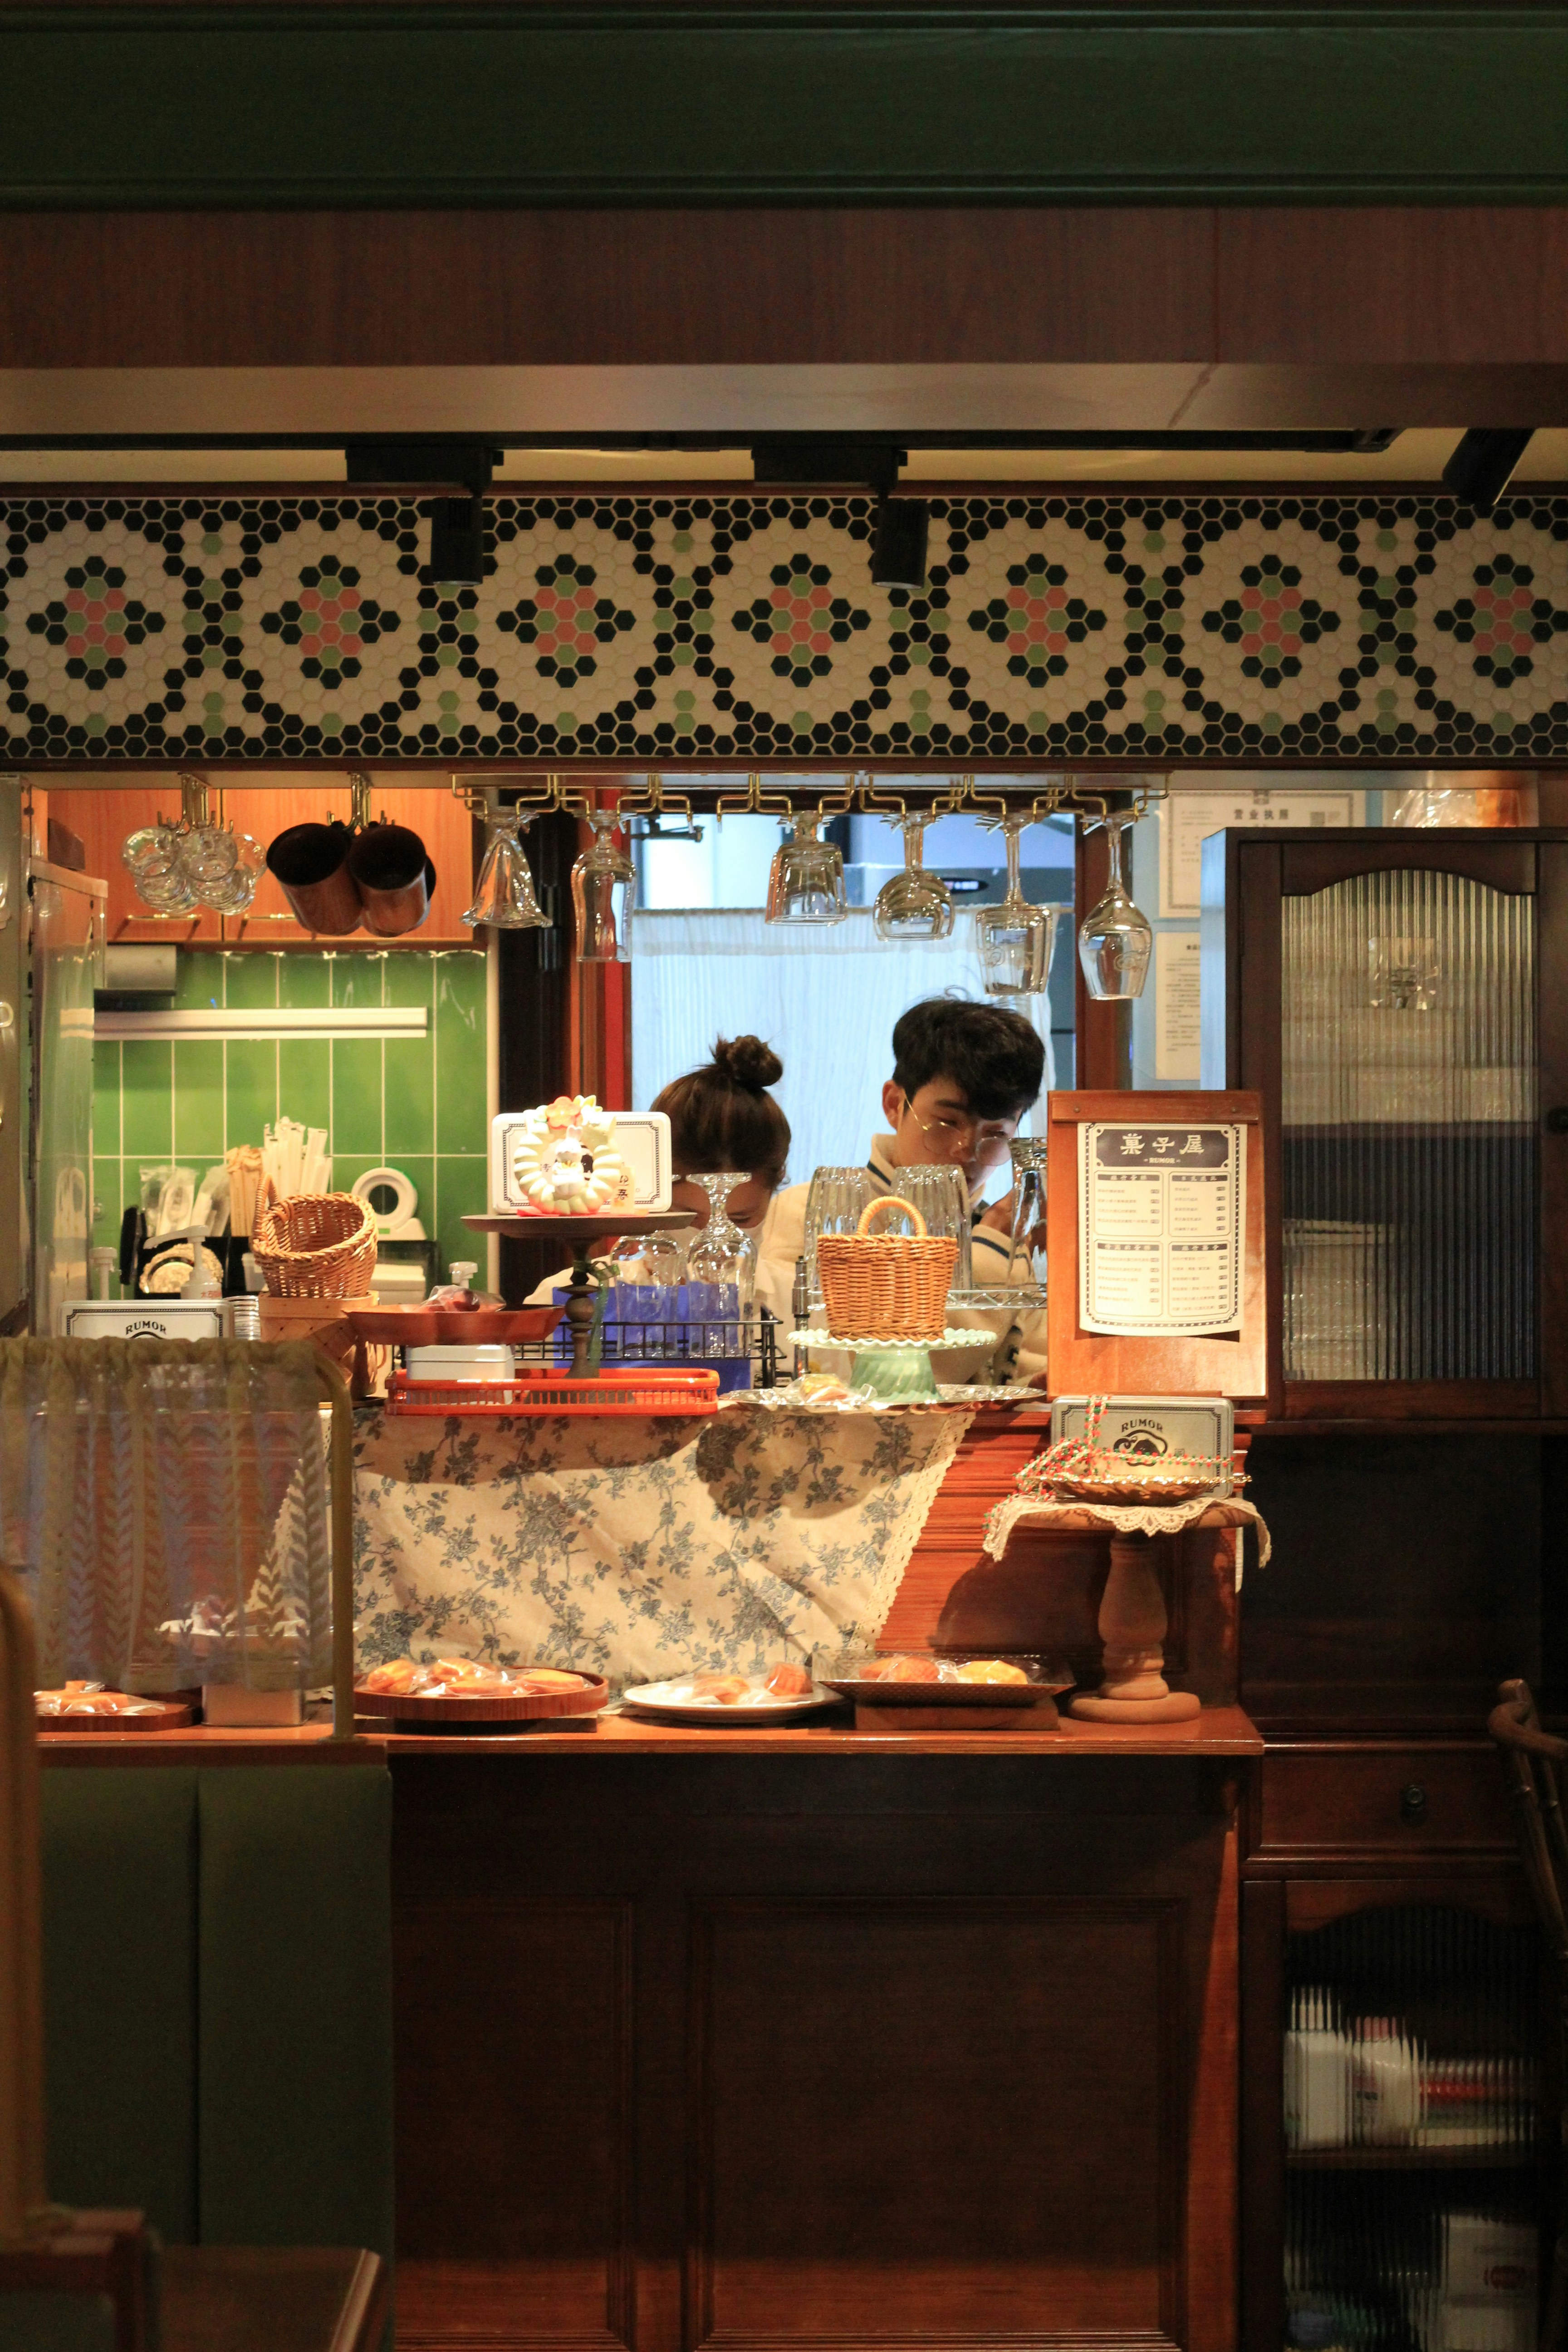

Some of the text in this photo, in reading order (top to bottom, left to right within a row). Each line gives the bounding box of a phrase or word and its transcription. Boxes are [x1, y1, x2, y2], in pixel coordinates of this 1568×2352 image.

[1234, 809, 1289, 819] 营业执照
[1120, 1133, 1205, 1155] 菓子屋
[126, 1321, 167, 1335] RUMOR
[1122, 1419, 1163, 1433] RUMOR
